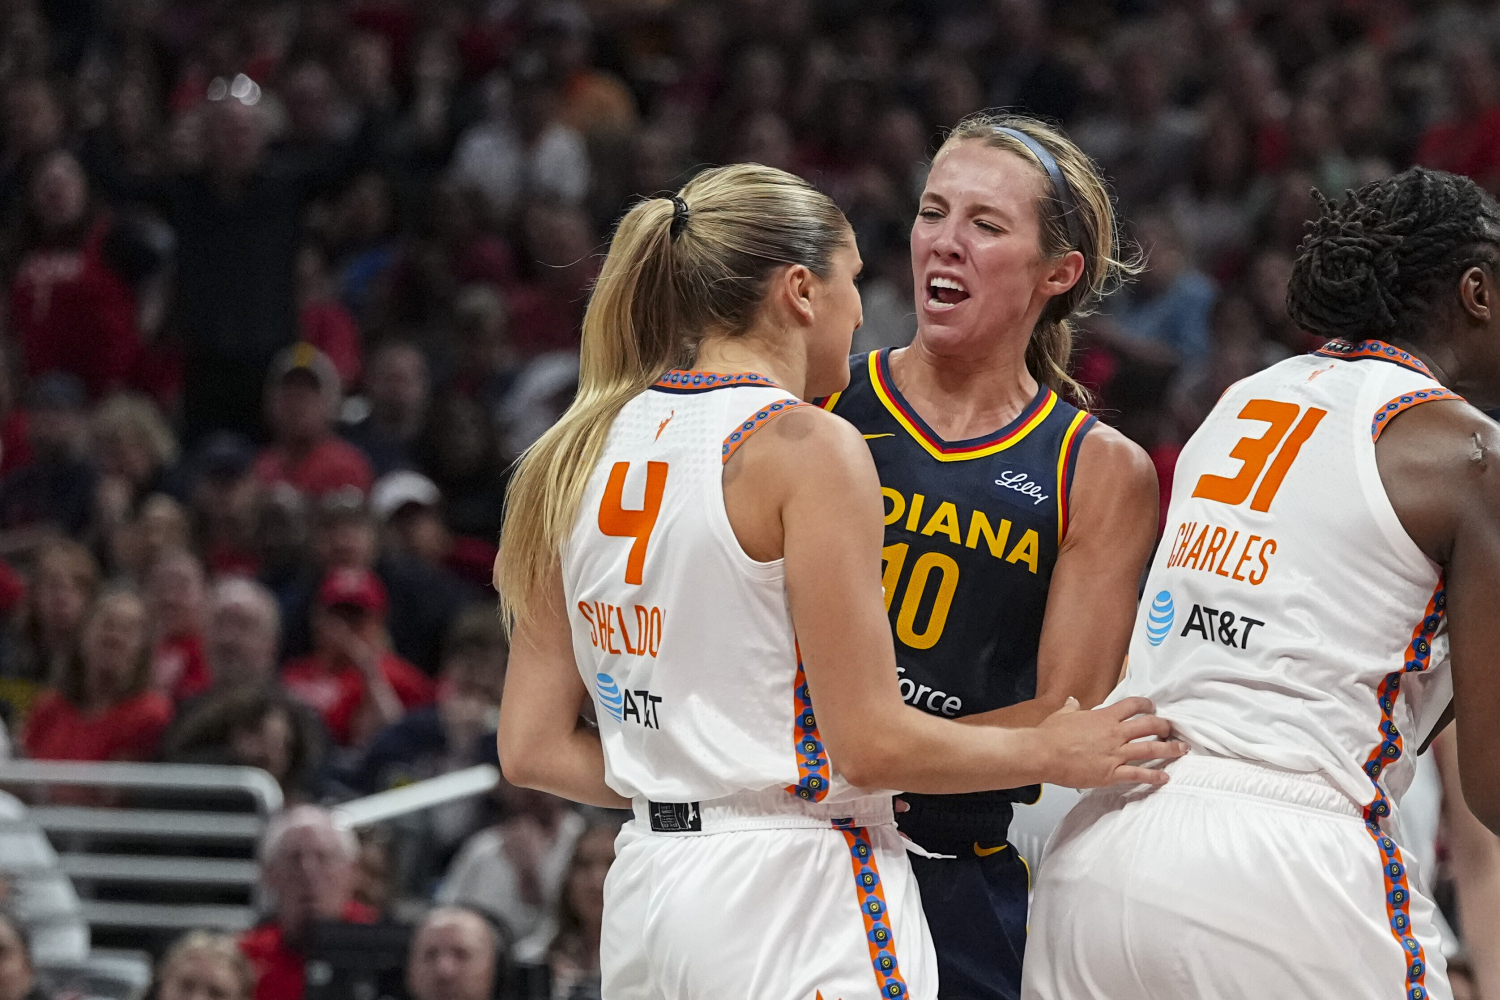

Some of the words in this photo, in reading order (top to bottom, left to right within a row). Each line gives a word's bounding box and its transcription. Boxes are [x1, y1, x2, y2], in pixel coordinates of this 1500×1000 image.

[994, 470, 1049, 505] Lilly
[1192, 398, 1328, 513] 31
[597, 461, 669, 586] 4
[880, 486, 1040, 575] DIANA
[1166, 521, 1278, 586] CHARLES
[577, 600, 667, 659] SHELDO
[881, 542, 960, 650] 10
[1180, 603, 1266, 650] AT&T
